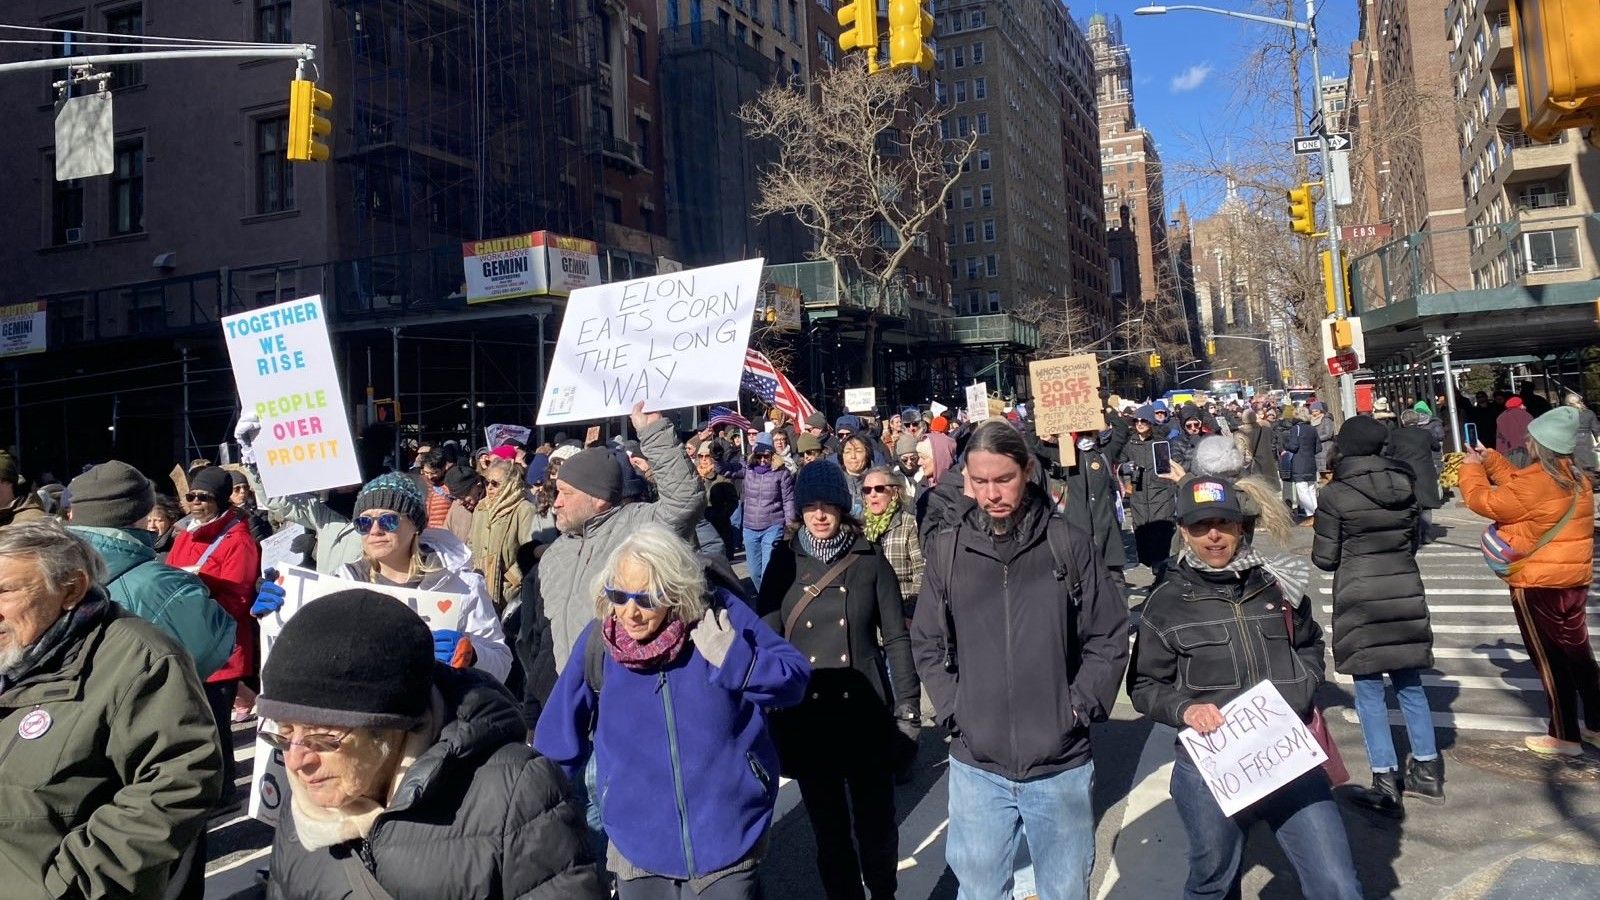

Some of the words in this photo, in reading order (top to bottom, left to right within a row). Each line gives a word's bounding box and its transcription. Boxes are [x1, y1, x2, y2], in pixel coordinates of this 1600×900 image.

[1302, 141, 1318, 149] ONE
[1353, 228, 1358, 237] E
[1368, 226, 1376, 235] St
[474, 235, 532, 255] CAUTION
[480, 253, 503, 262] WORK
[503, 249, 529, 258] ABOVE
[483, 256, 528, 277] GEMINI
[561, 257, 589, 276] GEMINI
[619, 275, 695, 312] ELON
[226, 302, 318, 339] TOGETHER
[577, 309, 653, 346] EATS
[666, 284, 740, 323] CORN
[259, 334, 287, 355] WE
[576, 343, 631, 374] THE
[648, 318, 737, 361] LONG
[256, 350, 305, 376] RISE
[602, 361, 677, 407] WAY
[1040, 376, 1091, 394] DOGE
[256, 389, 328, 420] PEOPLE
[1042, 388, 1091, 407] SHIT?
[273, 416, 323, 441] OVER
[266, 439, 339, 467] PROFIT
[1186, 726, 1227, 759] NO
[1224, 695, 1287, 739] FEAR
[1210, 772, 1241, 804] NO
[1238, 723, 1318, 784] FASCISM!
